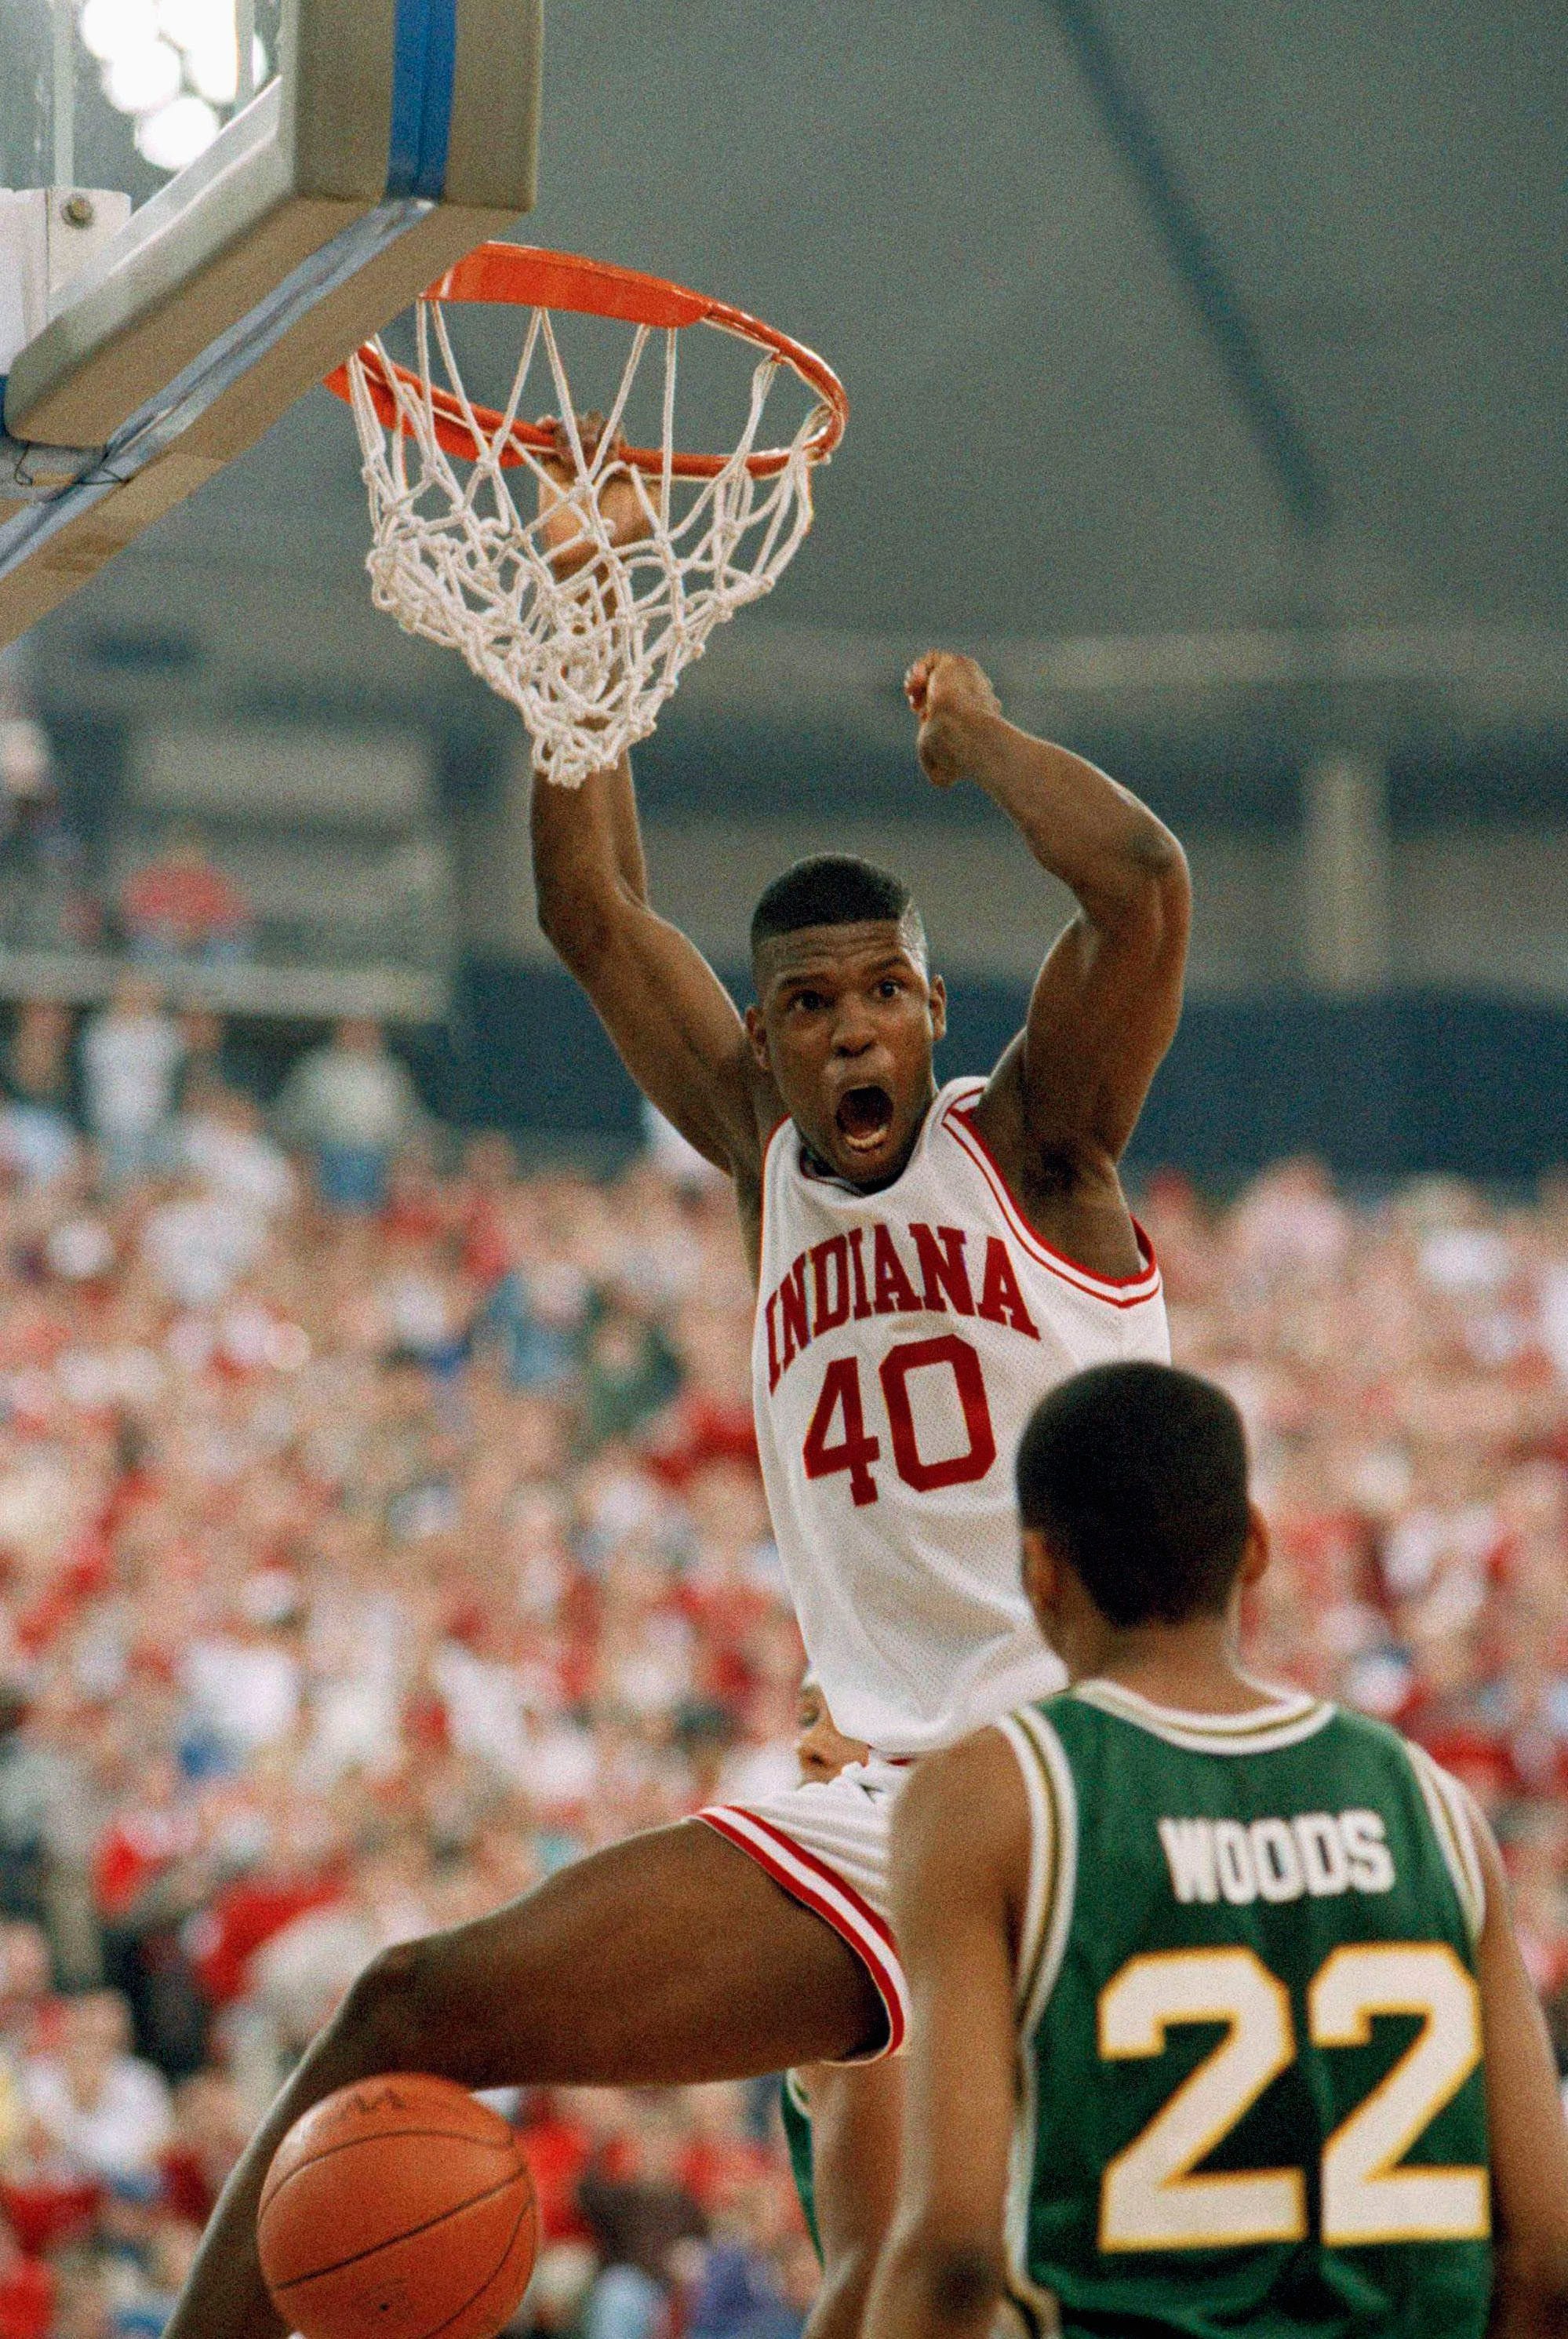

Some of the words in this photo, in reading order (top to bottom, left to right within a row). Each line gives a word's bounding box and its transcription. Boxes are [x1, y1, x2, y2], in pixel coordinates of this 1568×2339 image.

[766, 1222, 1042, 1397] INDIANA
[802, 1334, 997, 1507] 40
[1157, 1808, 1396, 1905] WOODS
[1097, 1941, 1490, 2253] 22
